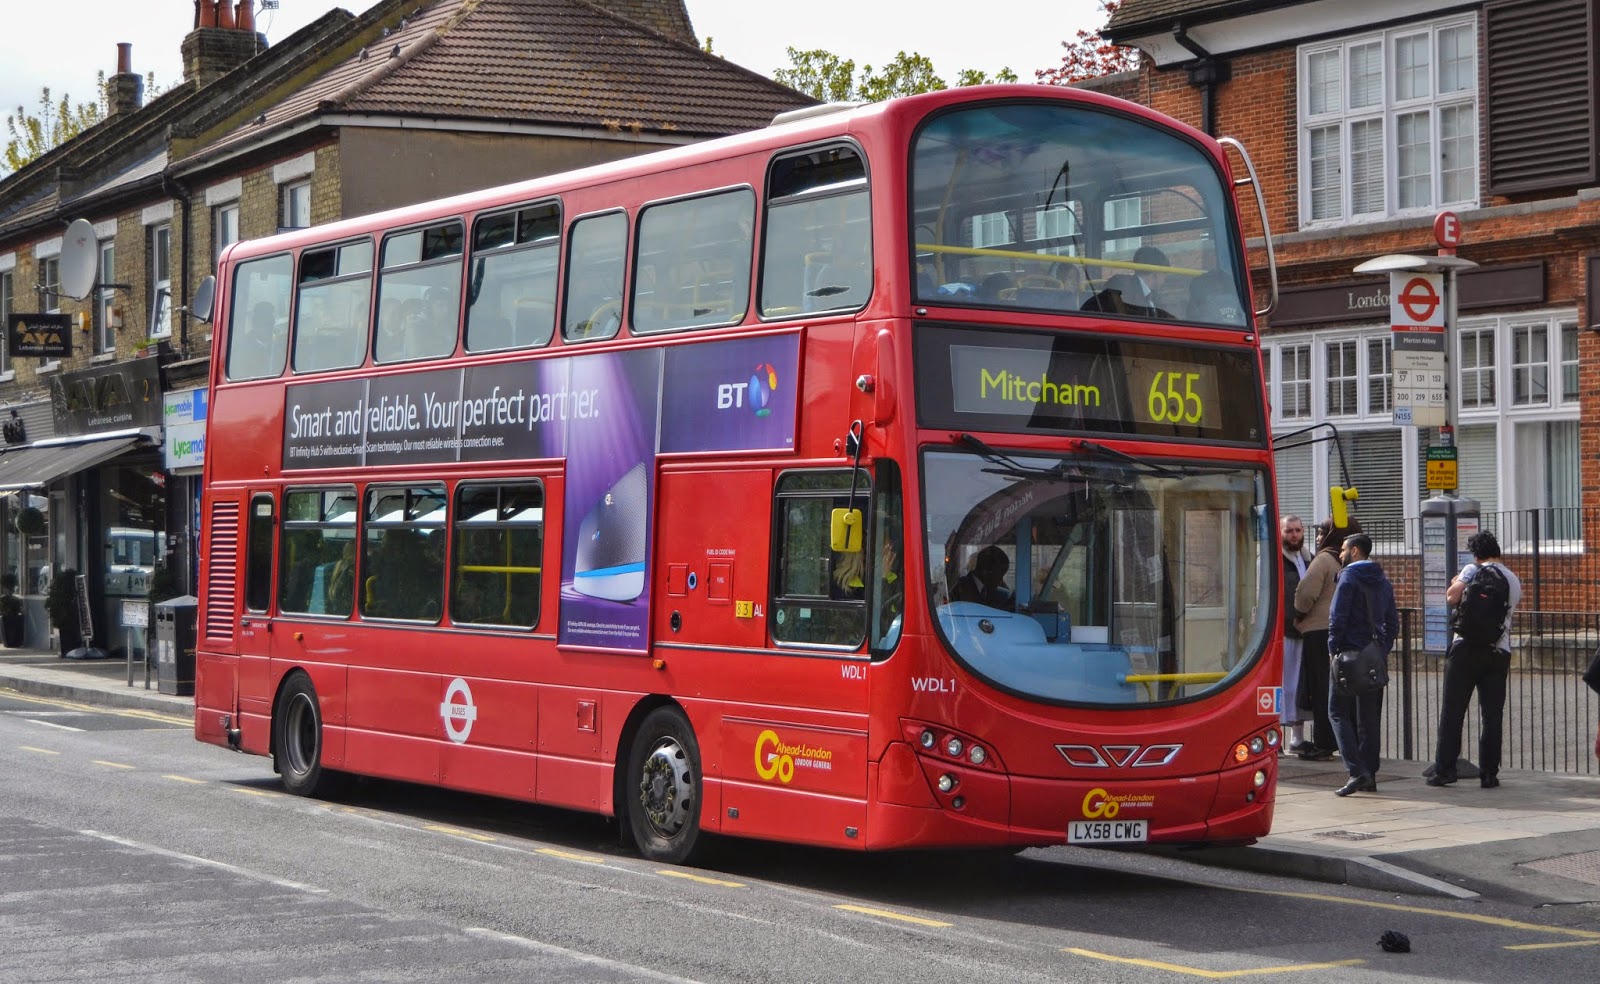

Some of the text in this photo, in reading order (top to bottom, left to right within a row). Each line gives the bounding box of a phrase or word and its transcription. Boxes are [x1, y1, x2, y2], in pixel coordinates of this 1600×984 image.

[1444, 216, 1456, 242] E
[22, 332, 62, 344] AYA
[718, 382, 748, 409] BT
[980, 368, 1202, 424] Mitcham 655
[165, 399, 192, 416] Lycamobile
[291, 384, 599, 438] Smart and reliable. Your perfect partner.
[88, 413, 132, 426] Lebanese cuisine
[290, 446, 296, 457] BT
[296, 446, 310, 458] Infinity
[311, 445, 319, 456] Hub
[324, 444, 333, 456] with
[333, 444, 352, 455] exclusive
[403, 439, 412, 450] Our
[413, 440, 425, 450] most
[425, 438, 443, 449] reliable
[443, 437, 463, 449] wireless
[463, 435, 491, 447] connection
[492, 436, 504, 446] ever.
[753, 604, 764, 617] AL
[842, 664, 866, 680] WDL1
[912, 677, 955, 692] WDL1
[452, 706, 466, 716] BUSES
[755, 730, 794, 782] Go
[776, 743, 832, 760] Ahead-London
[795, 758, 832, 770] LONDON GENERAL
[1082, 788, 1120, 818] Go
[1074, 822, 1141, 840] LX58 CWG
